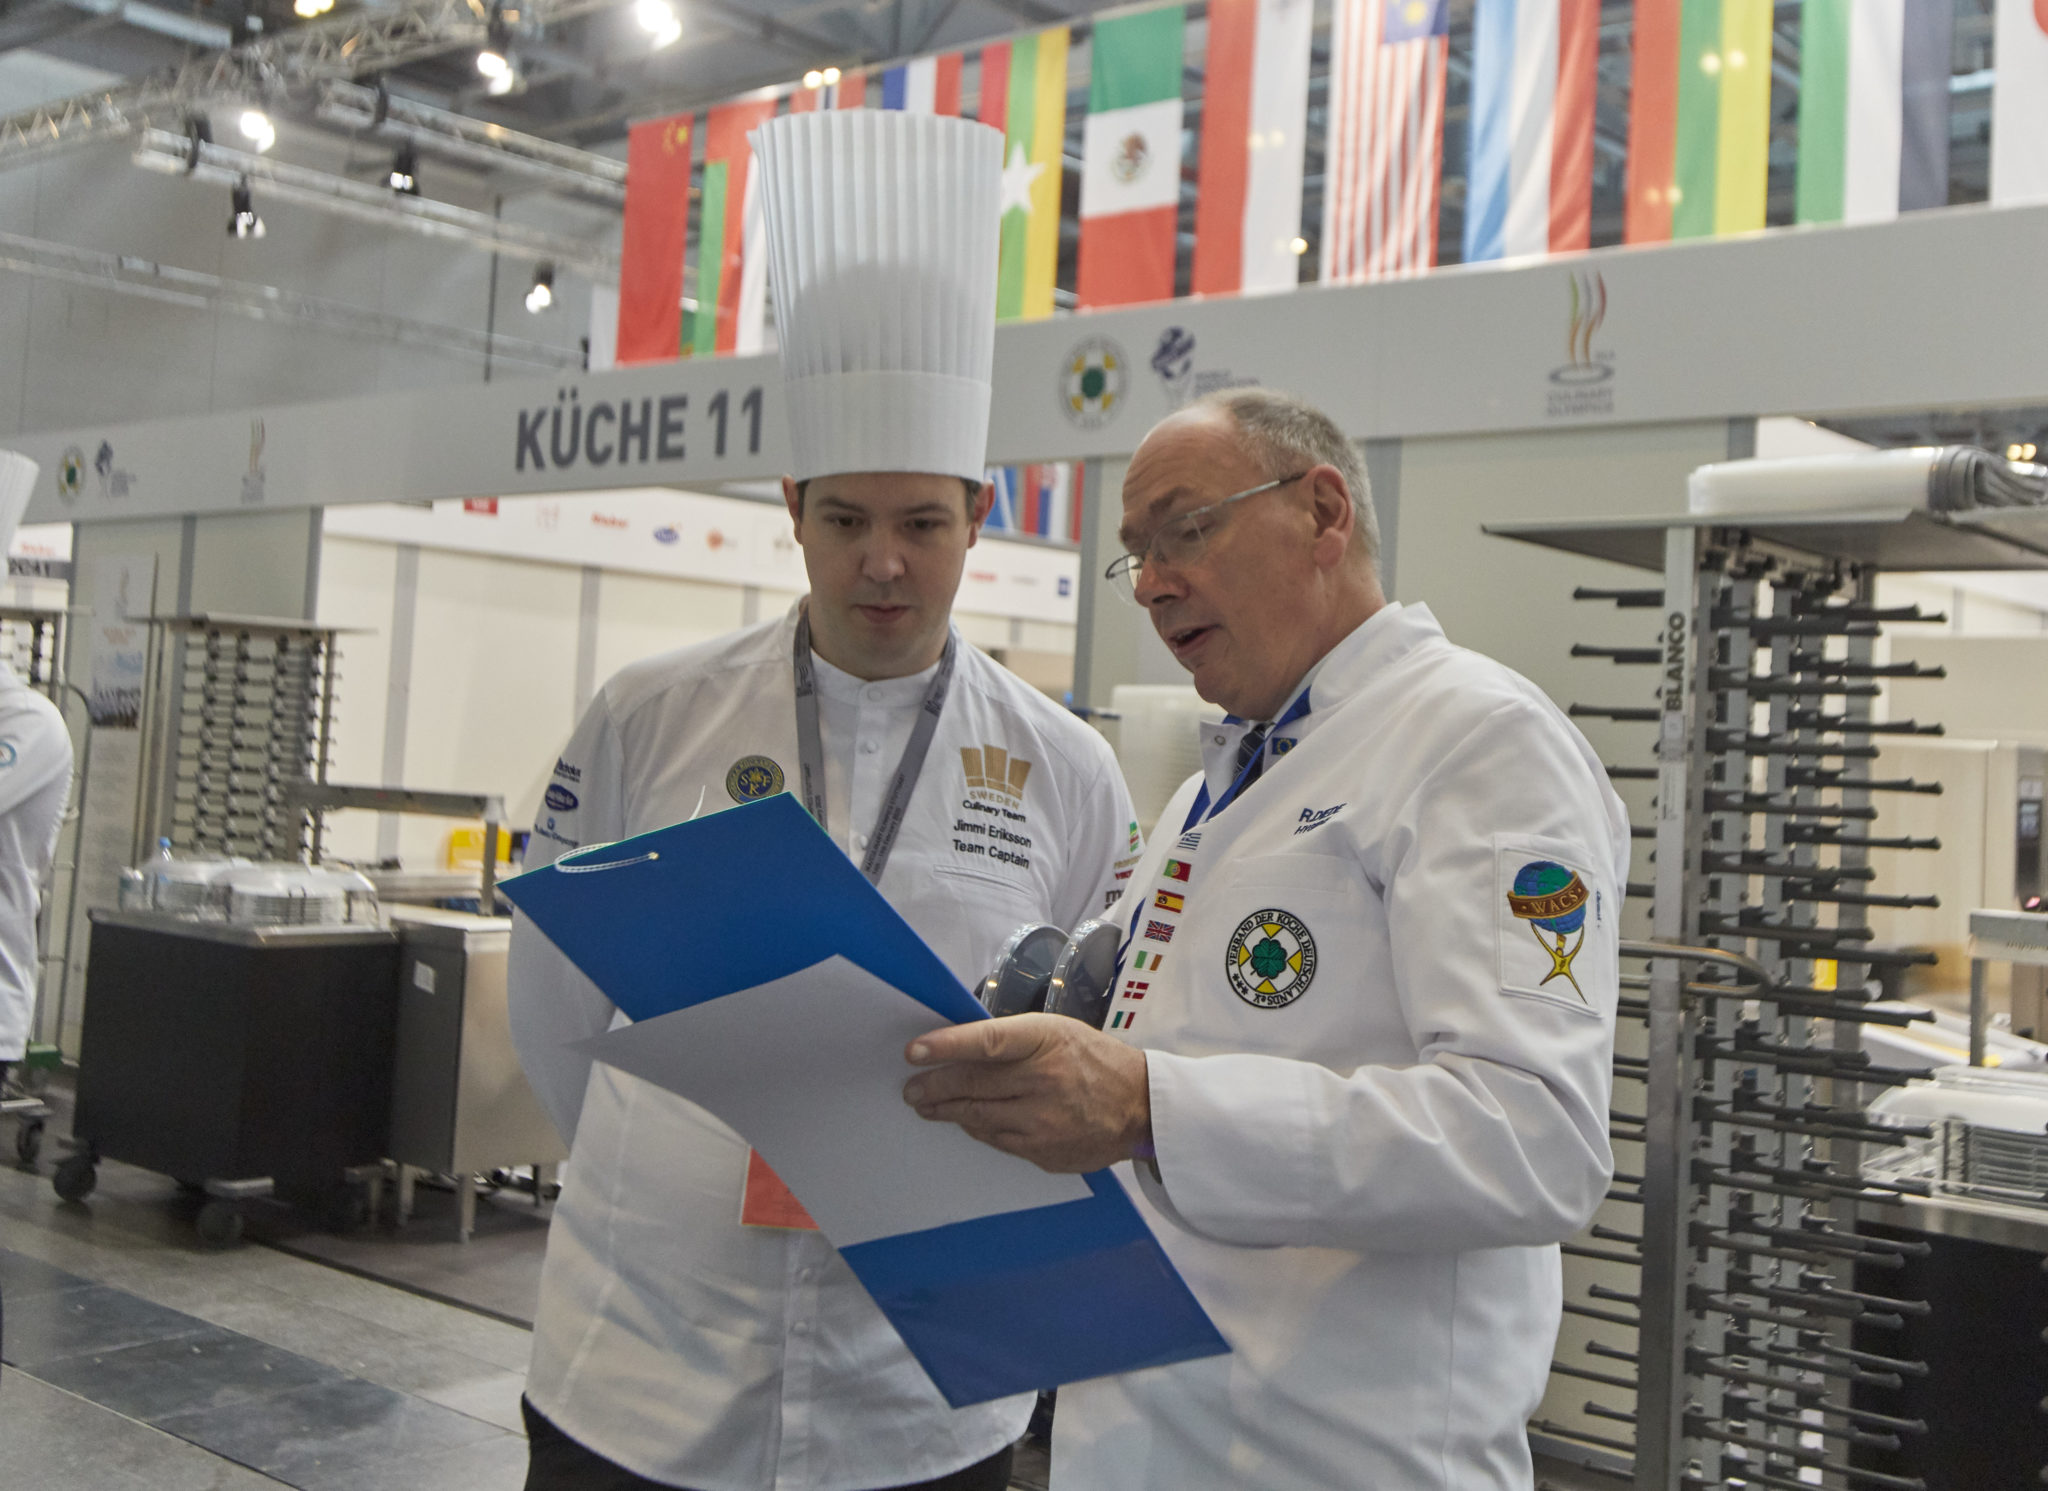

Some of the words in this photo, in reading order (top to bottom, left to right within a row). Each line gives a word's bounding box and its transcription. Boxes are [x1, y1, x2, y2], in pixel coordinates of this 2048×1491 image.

[515, 386, 689, 472] KÜCHE
[708, 386, 763, 457] 11
[1666, 612, 1685, 711] BLANCO
[962, 800, 1000, 816] Culinary
[1001, 808, 1026, 822] Team
[968, 790, 1020, 809] SWEDEN
[953, 819, 986, 835] Jimmi
[988, 825, 1032, 848] Eriksson
[952, 839, 985, 855] Team
[988, 846, 1029, 870] Captain
[1530, 891, 1579, 914] WACS
[1229, 920, 1254, 966] VERBAND
[1254, 912, 1274, 926] DER
[1267, 938, 1314, 1006] DEUTSCHLANDS
